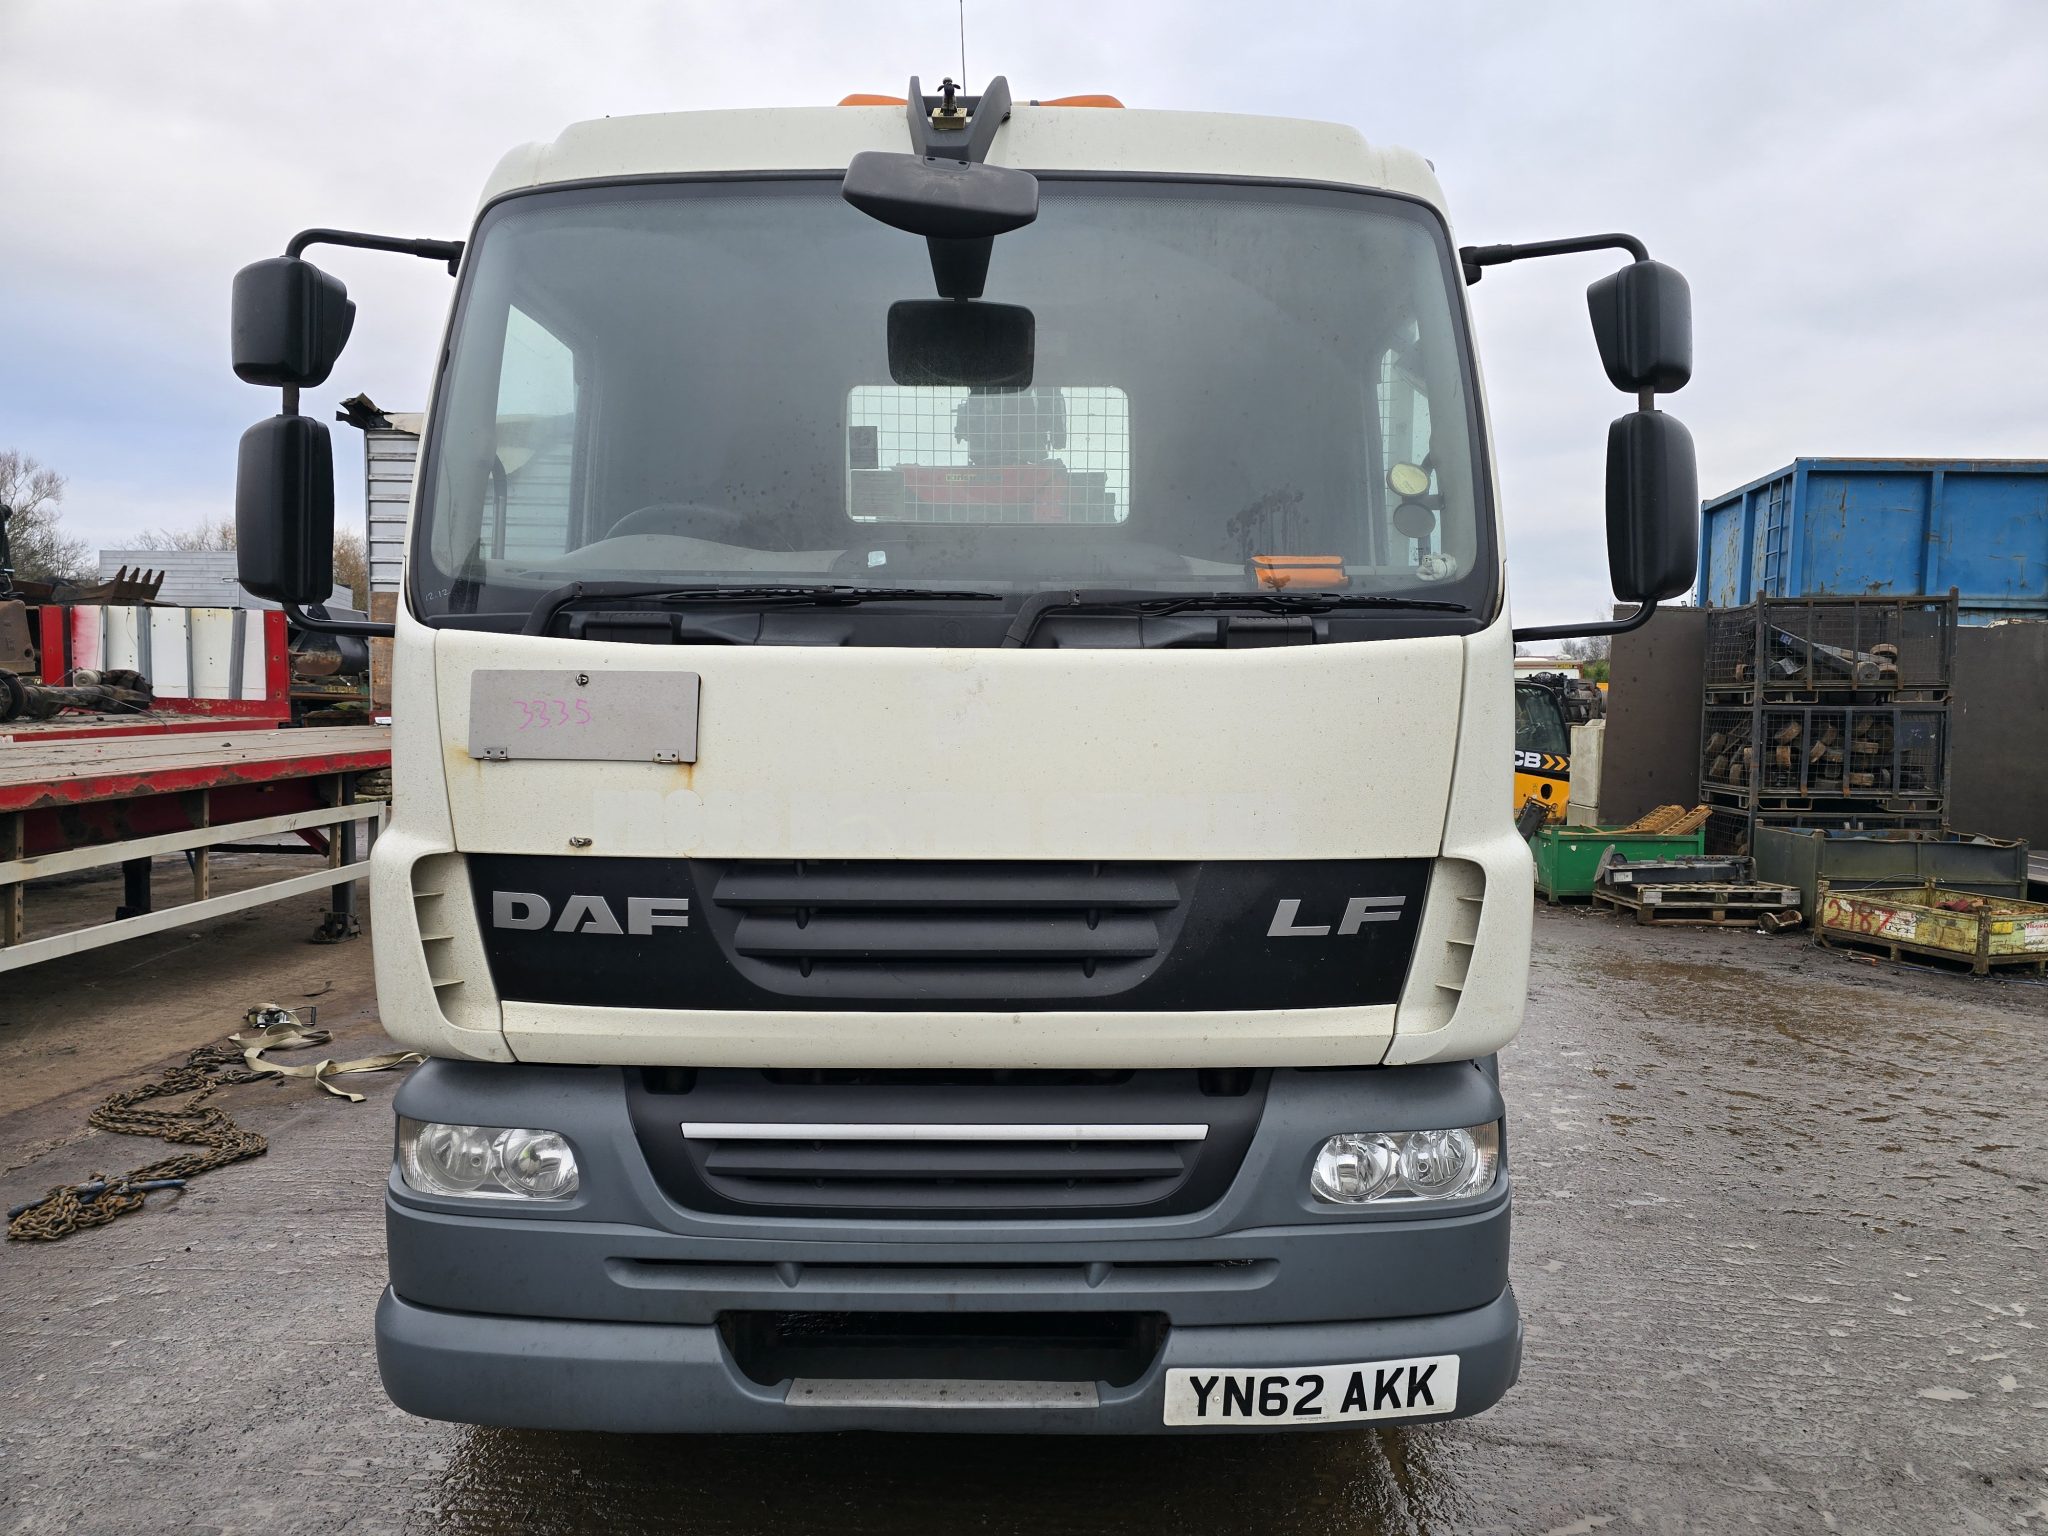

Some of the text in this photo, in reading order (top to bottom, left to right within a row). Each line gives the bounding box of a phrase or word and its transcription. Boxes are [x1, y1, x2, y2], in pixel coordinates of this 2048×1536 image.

[513, 700, 592, 730] 3335
[493, 890, 689, 935] DAF
[1266, 895, 1407, 937] LF
[1189, 1364, 1438, 1417] YN62 AKK
